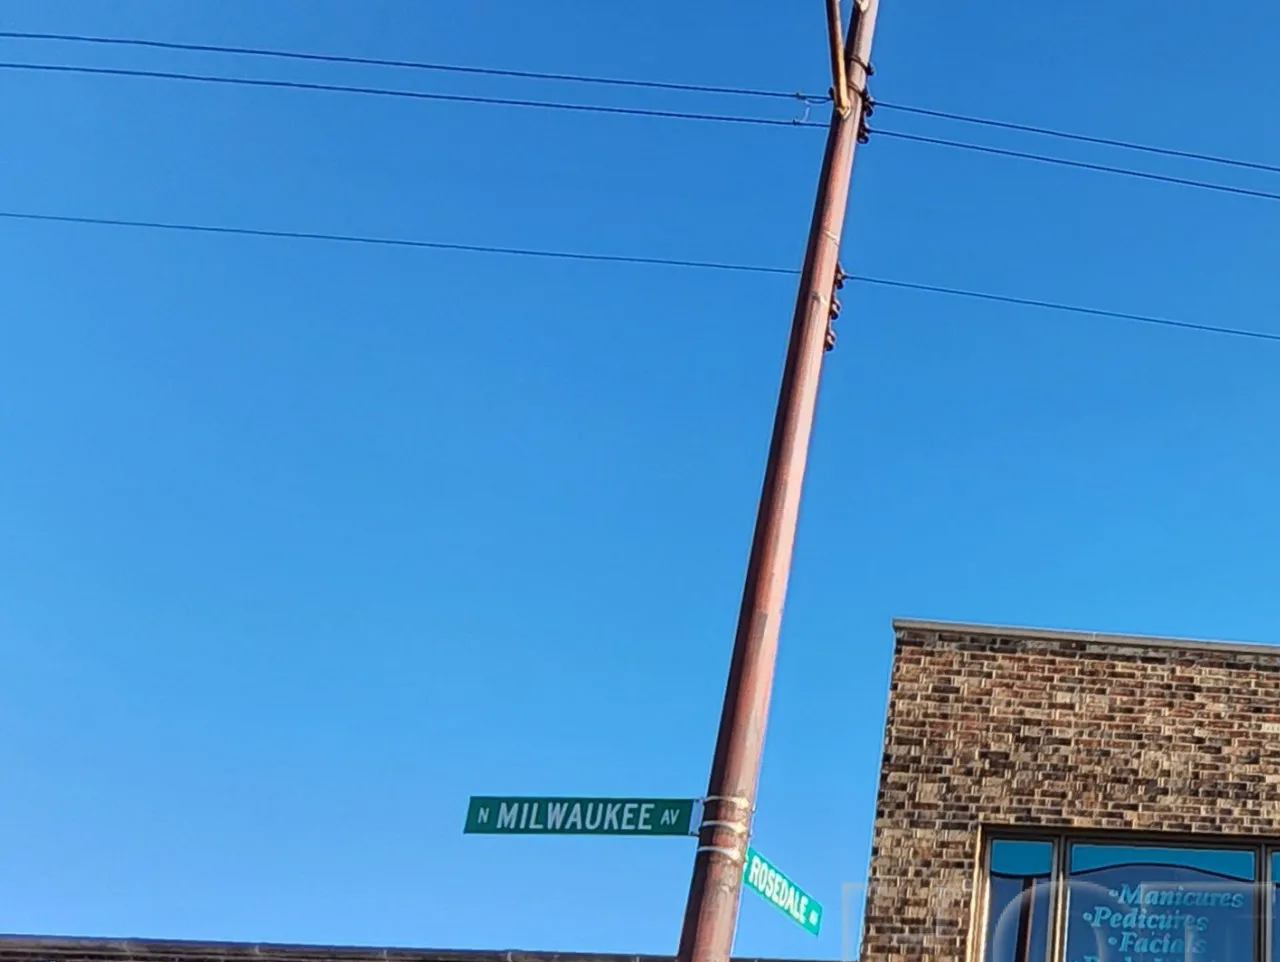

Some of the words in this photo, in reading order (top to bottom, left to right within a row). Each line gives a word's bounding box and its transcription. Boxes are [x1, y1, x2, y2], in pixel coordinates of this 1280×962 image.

[477, 807, 489, 825] N
[497, 803, 655, 831] MILWAUKEE
[660, 808, 680, 826] AV
[748, 854, 809, 925] ROSEDALE
[1117, 883, 1245, 909] Manicures
[1091, 906, 1210, 932] Pedicures
